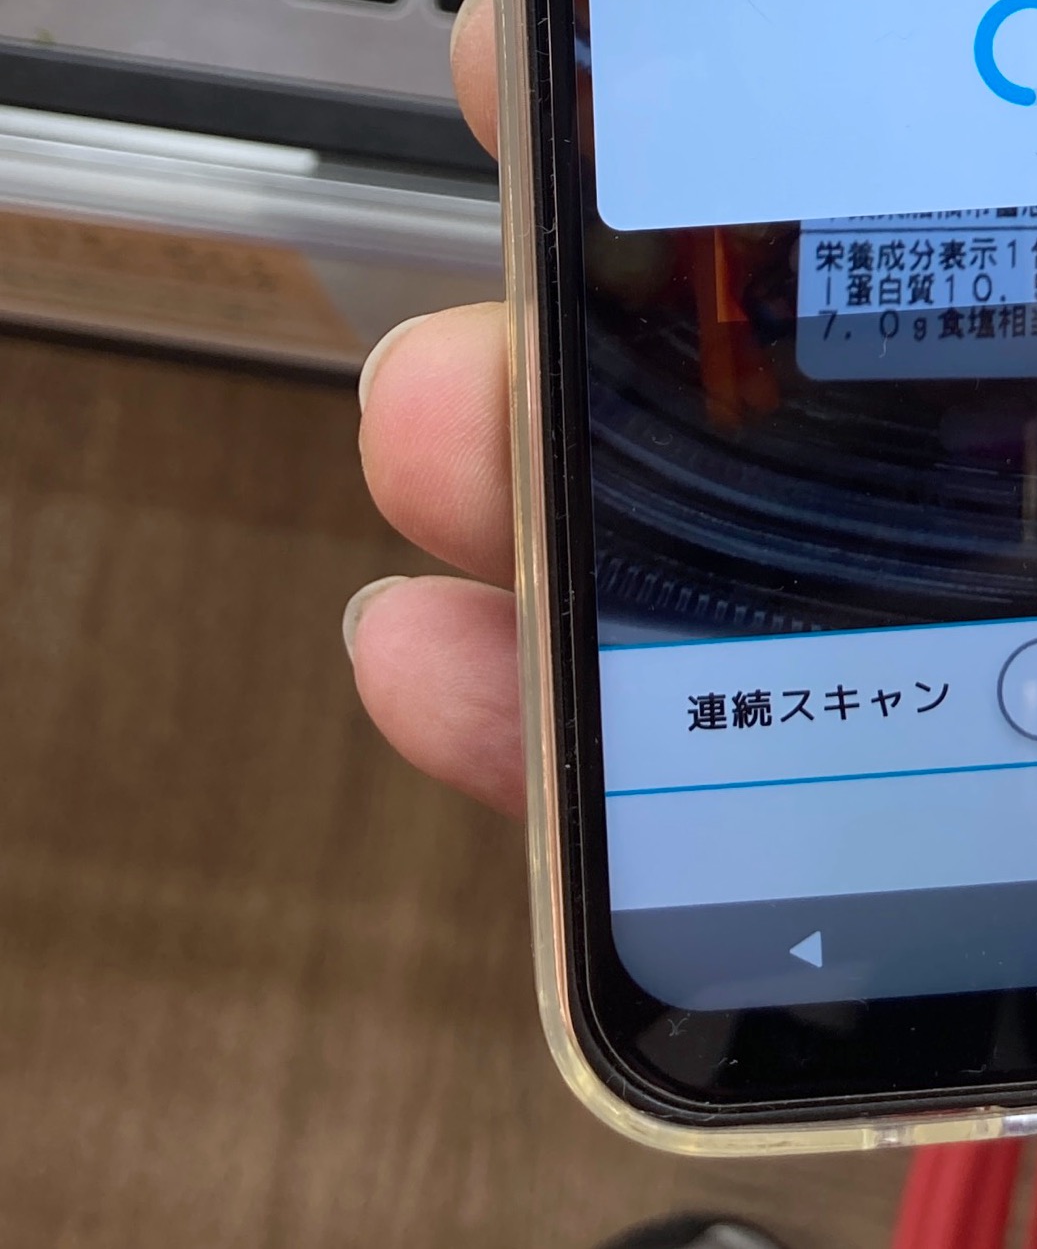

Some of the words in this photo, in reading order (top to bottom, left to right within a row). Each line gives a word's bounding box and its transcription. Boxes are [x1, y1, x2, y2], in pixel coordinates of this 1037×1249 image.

[687, 681, 950, 732] 連続スキャン
